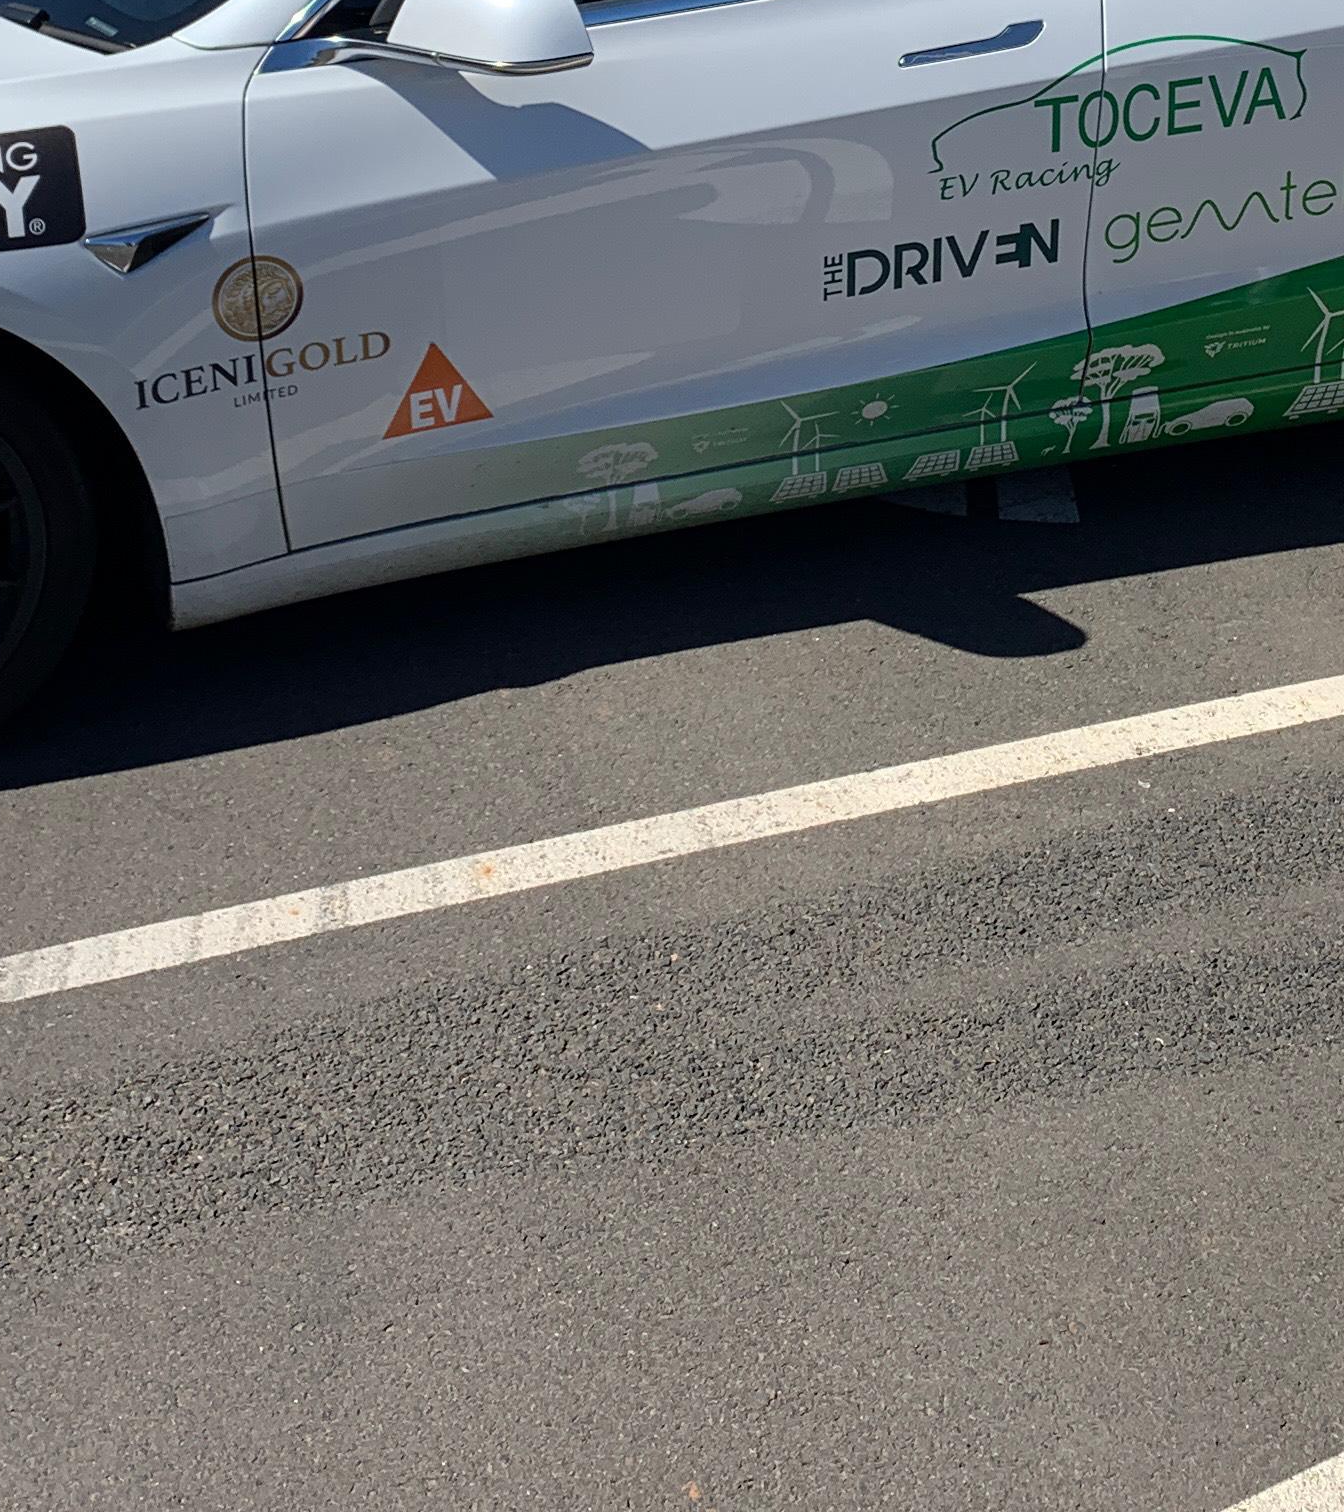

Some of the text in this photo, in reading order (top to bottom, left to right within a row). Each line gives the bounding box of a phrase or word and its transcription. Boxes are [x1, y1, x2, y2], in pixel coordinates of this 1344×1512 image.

[1033, 66, 1287, 153] TOCEVA
[939, 156, 1122, 200] EV Racing
[823, 218, 1060, 301] THE DRIVEN
[1227, 338, 1267, 349] TRITIUM
[233, 384, 299, 409] LIMITED
[411, 384, 463, 430] EV
